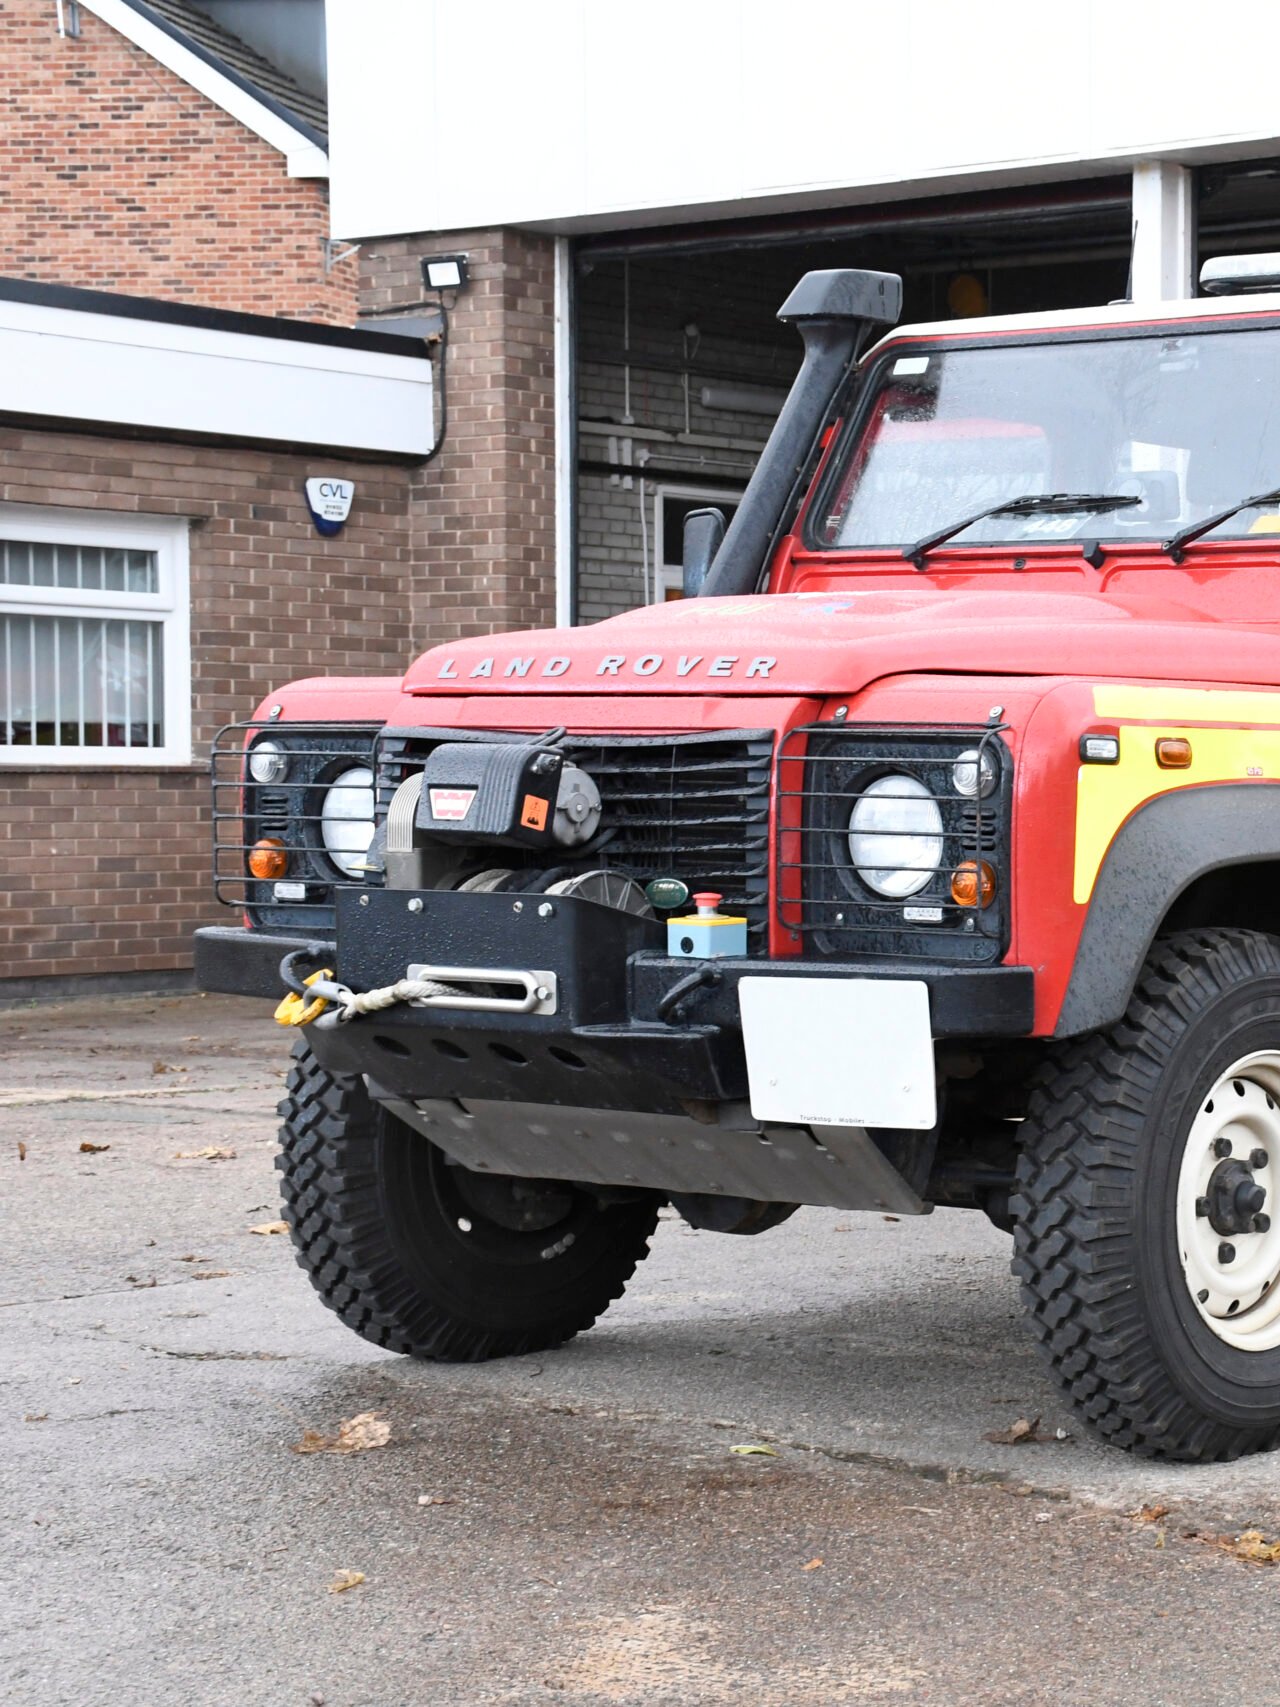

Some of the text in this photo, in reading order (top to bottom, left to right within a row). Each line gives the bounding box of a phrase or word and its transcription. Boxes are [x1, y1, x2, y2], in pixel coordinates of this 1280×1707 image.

[319, 483, 348, 499] CVL
[437, 654, 778, 679] LAND ROVER
[800, 1114, 832, 1123] Truckstop
